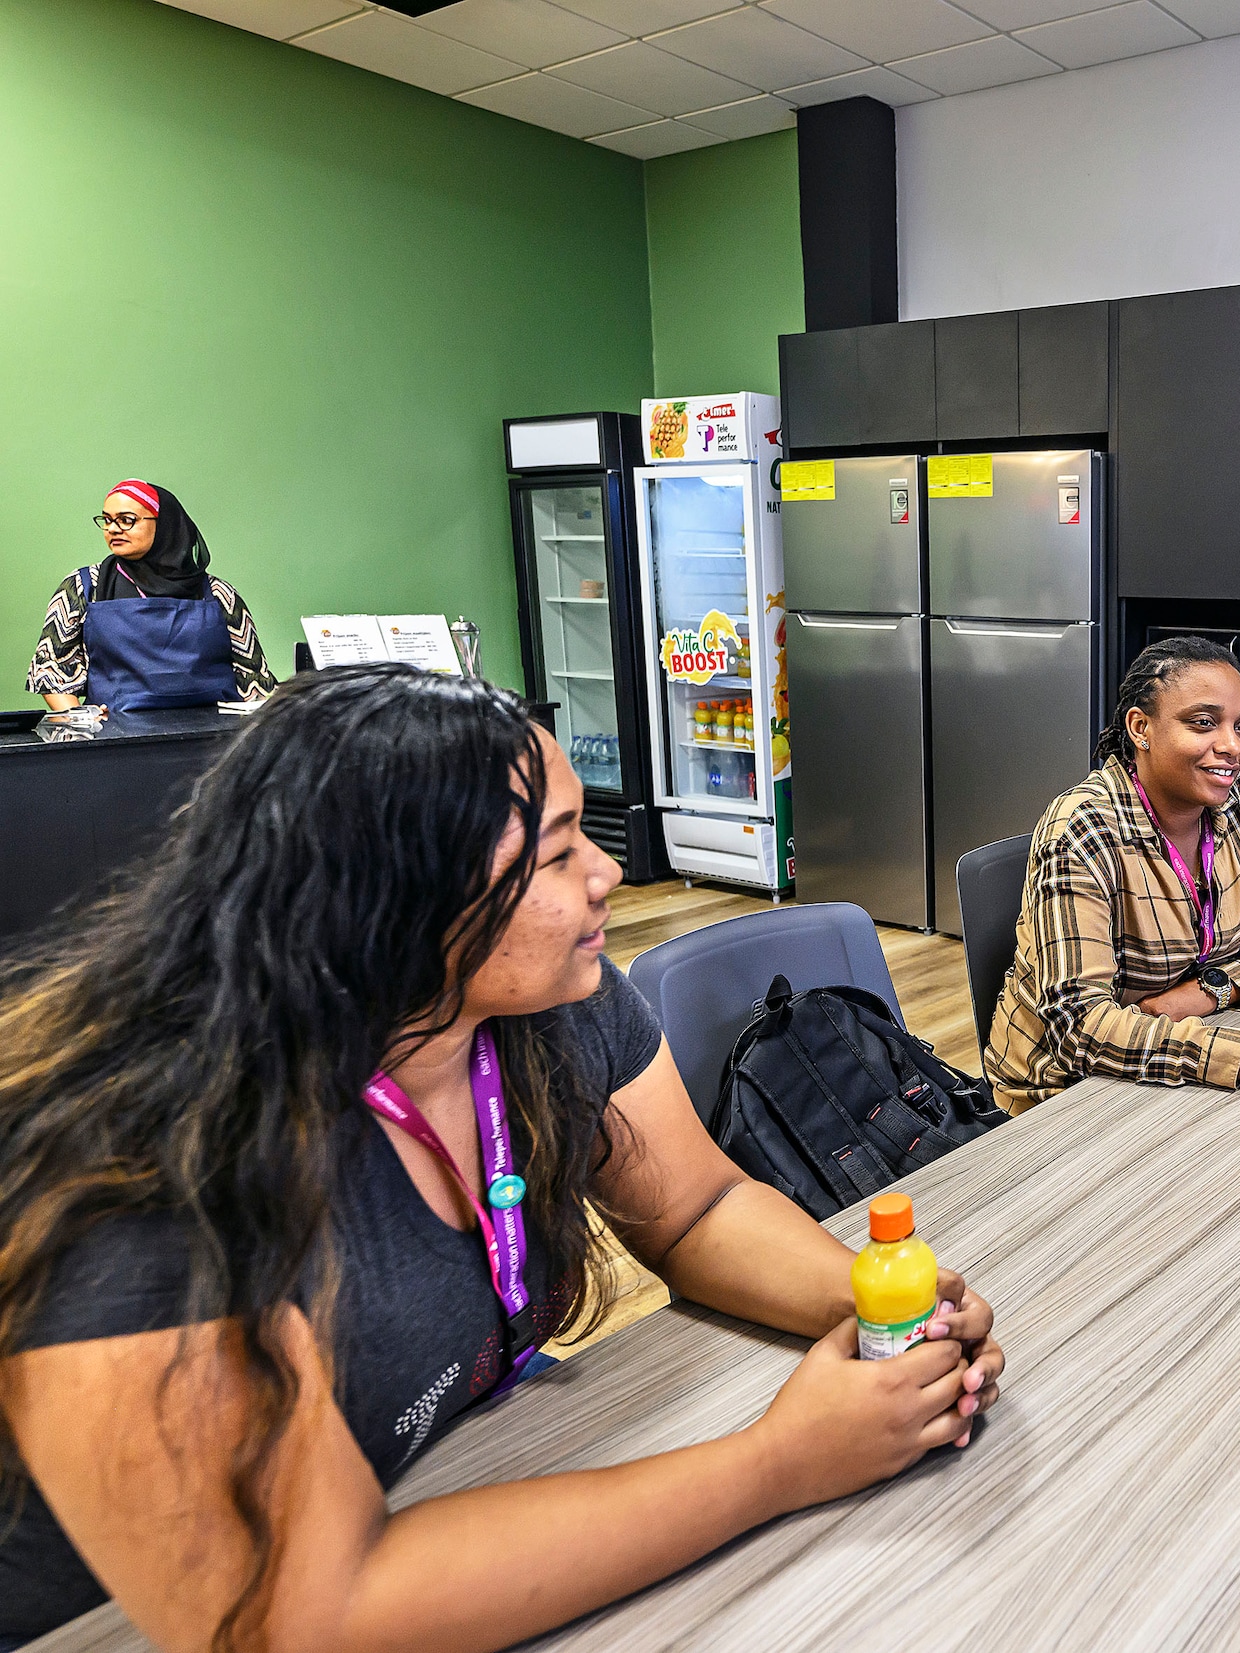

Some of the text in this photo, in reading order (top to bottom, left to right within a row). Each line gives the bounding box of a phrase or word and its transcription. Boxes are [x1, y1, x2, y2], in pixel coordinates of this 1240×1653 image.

[716, 424, 728, 433] Tele
[718, 433, 736, 444] perfor
[672, 632, 714, 655] Vita C
[672, 651, 726, 673] BOOST
[1174, 858, 1182, 870] each
[478, 1051, 491, 1076] each
[488, 1096, 508, 1171] Teleperformance
[503, 1208, 518, 1245] matters
[508, 1244, 521, 1290] interaction
